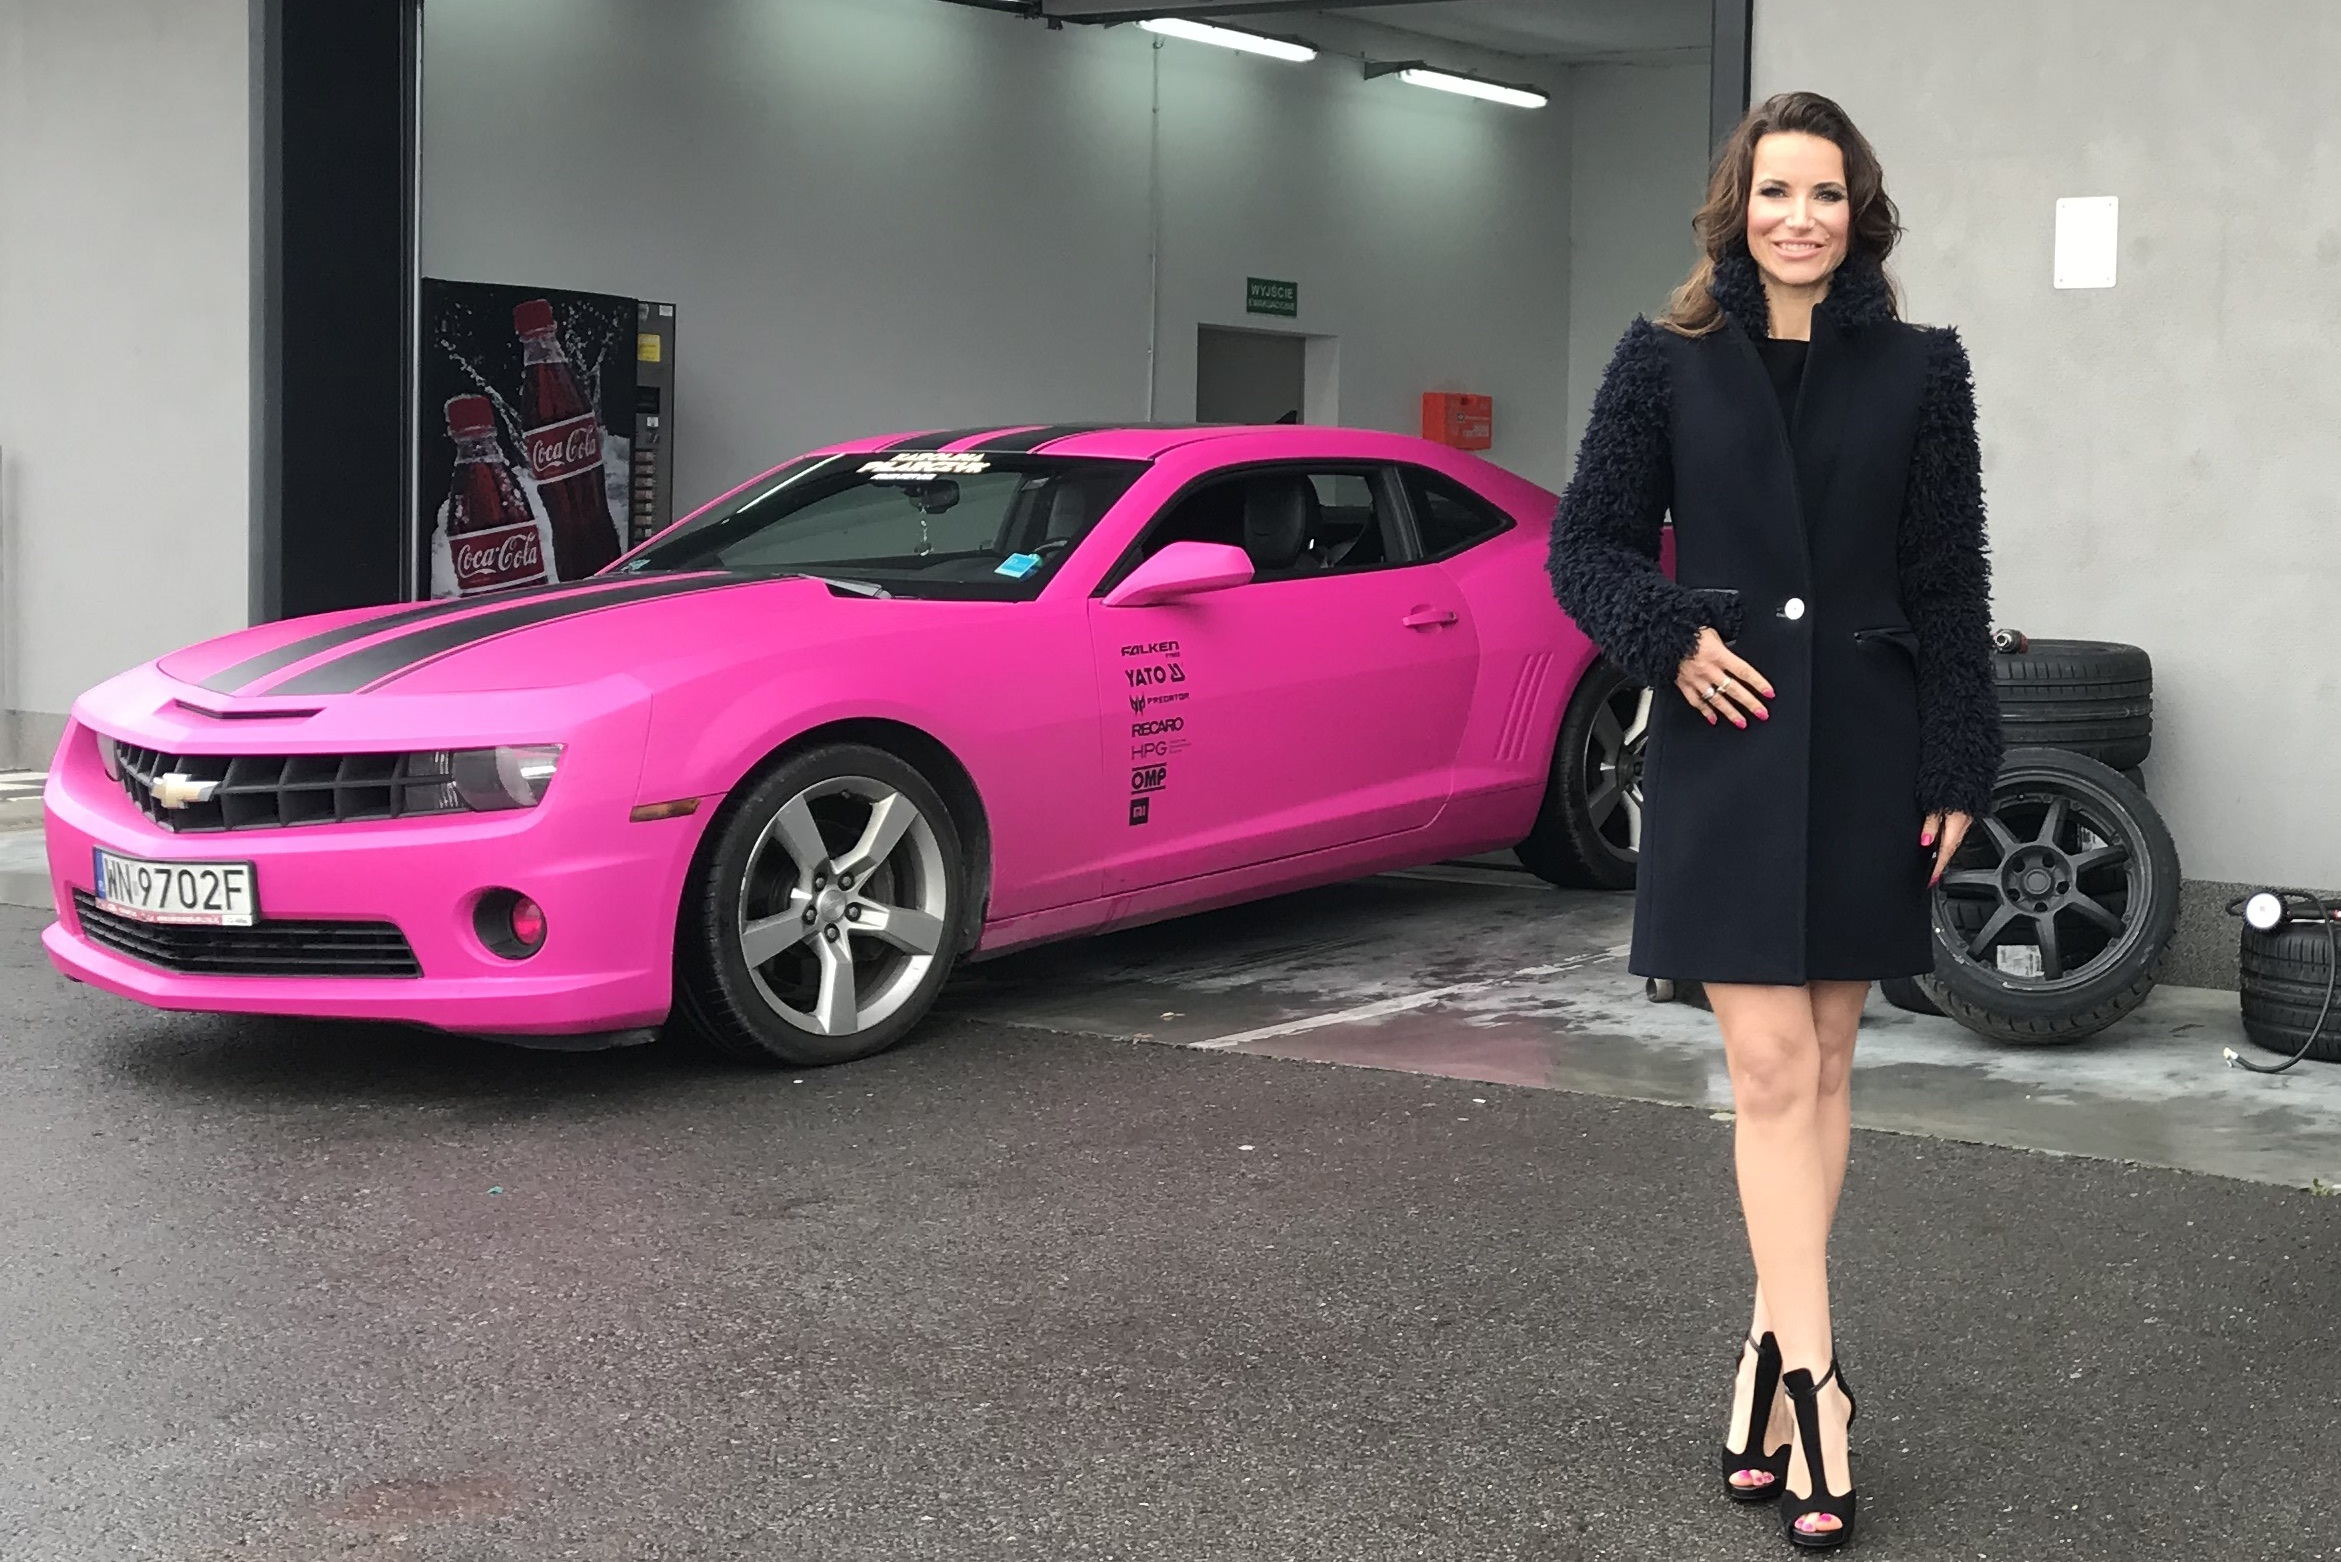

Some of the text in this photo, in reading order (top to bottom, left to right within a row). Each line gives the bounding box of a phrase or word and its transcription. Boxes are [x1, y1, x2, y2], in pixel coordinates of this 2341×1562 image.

[1251, 284, 1294, 300] WYJŚCIE
[1121, 641, 1179, 656] FALKEN
[1125, 665, 1166, 687] YATO
[1147, 692, 1190, 705] PREDATOR
[1131, 716, 1184, 737] RECARO
[1131, 741, 1168, 760] HPG
[1131, 767, 1167, 789] OMP
[138, 867, 245, 911] 9702F
